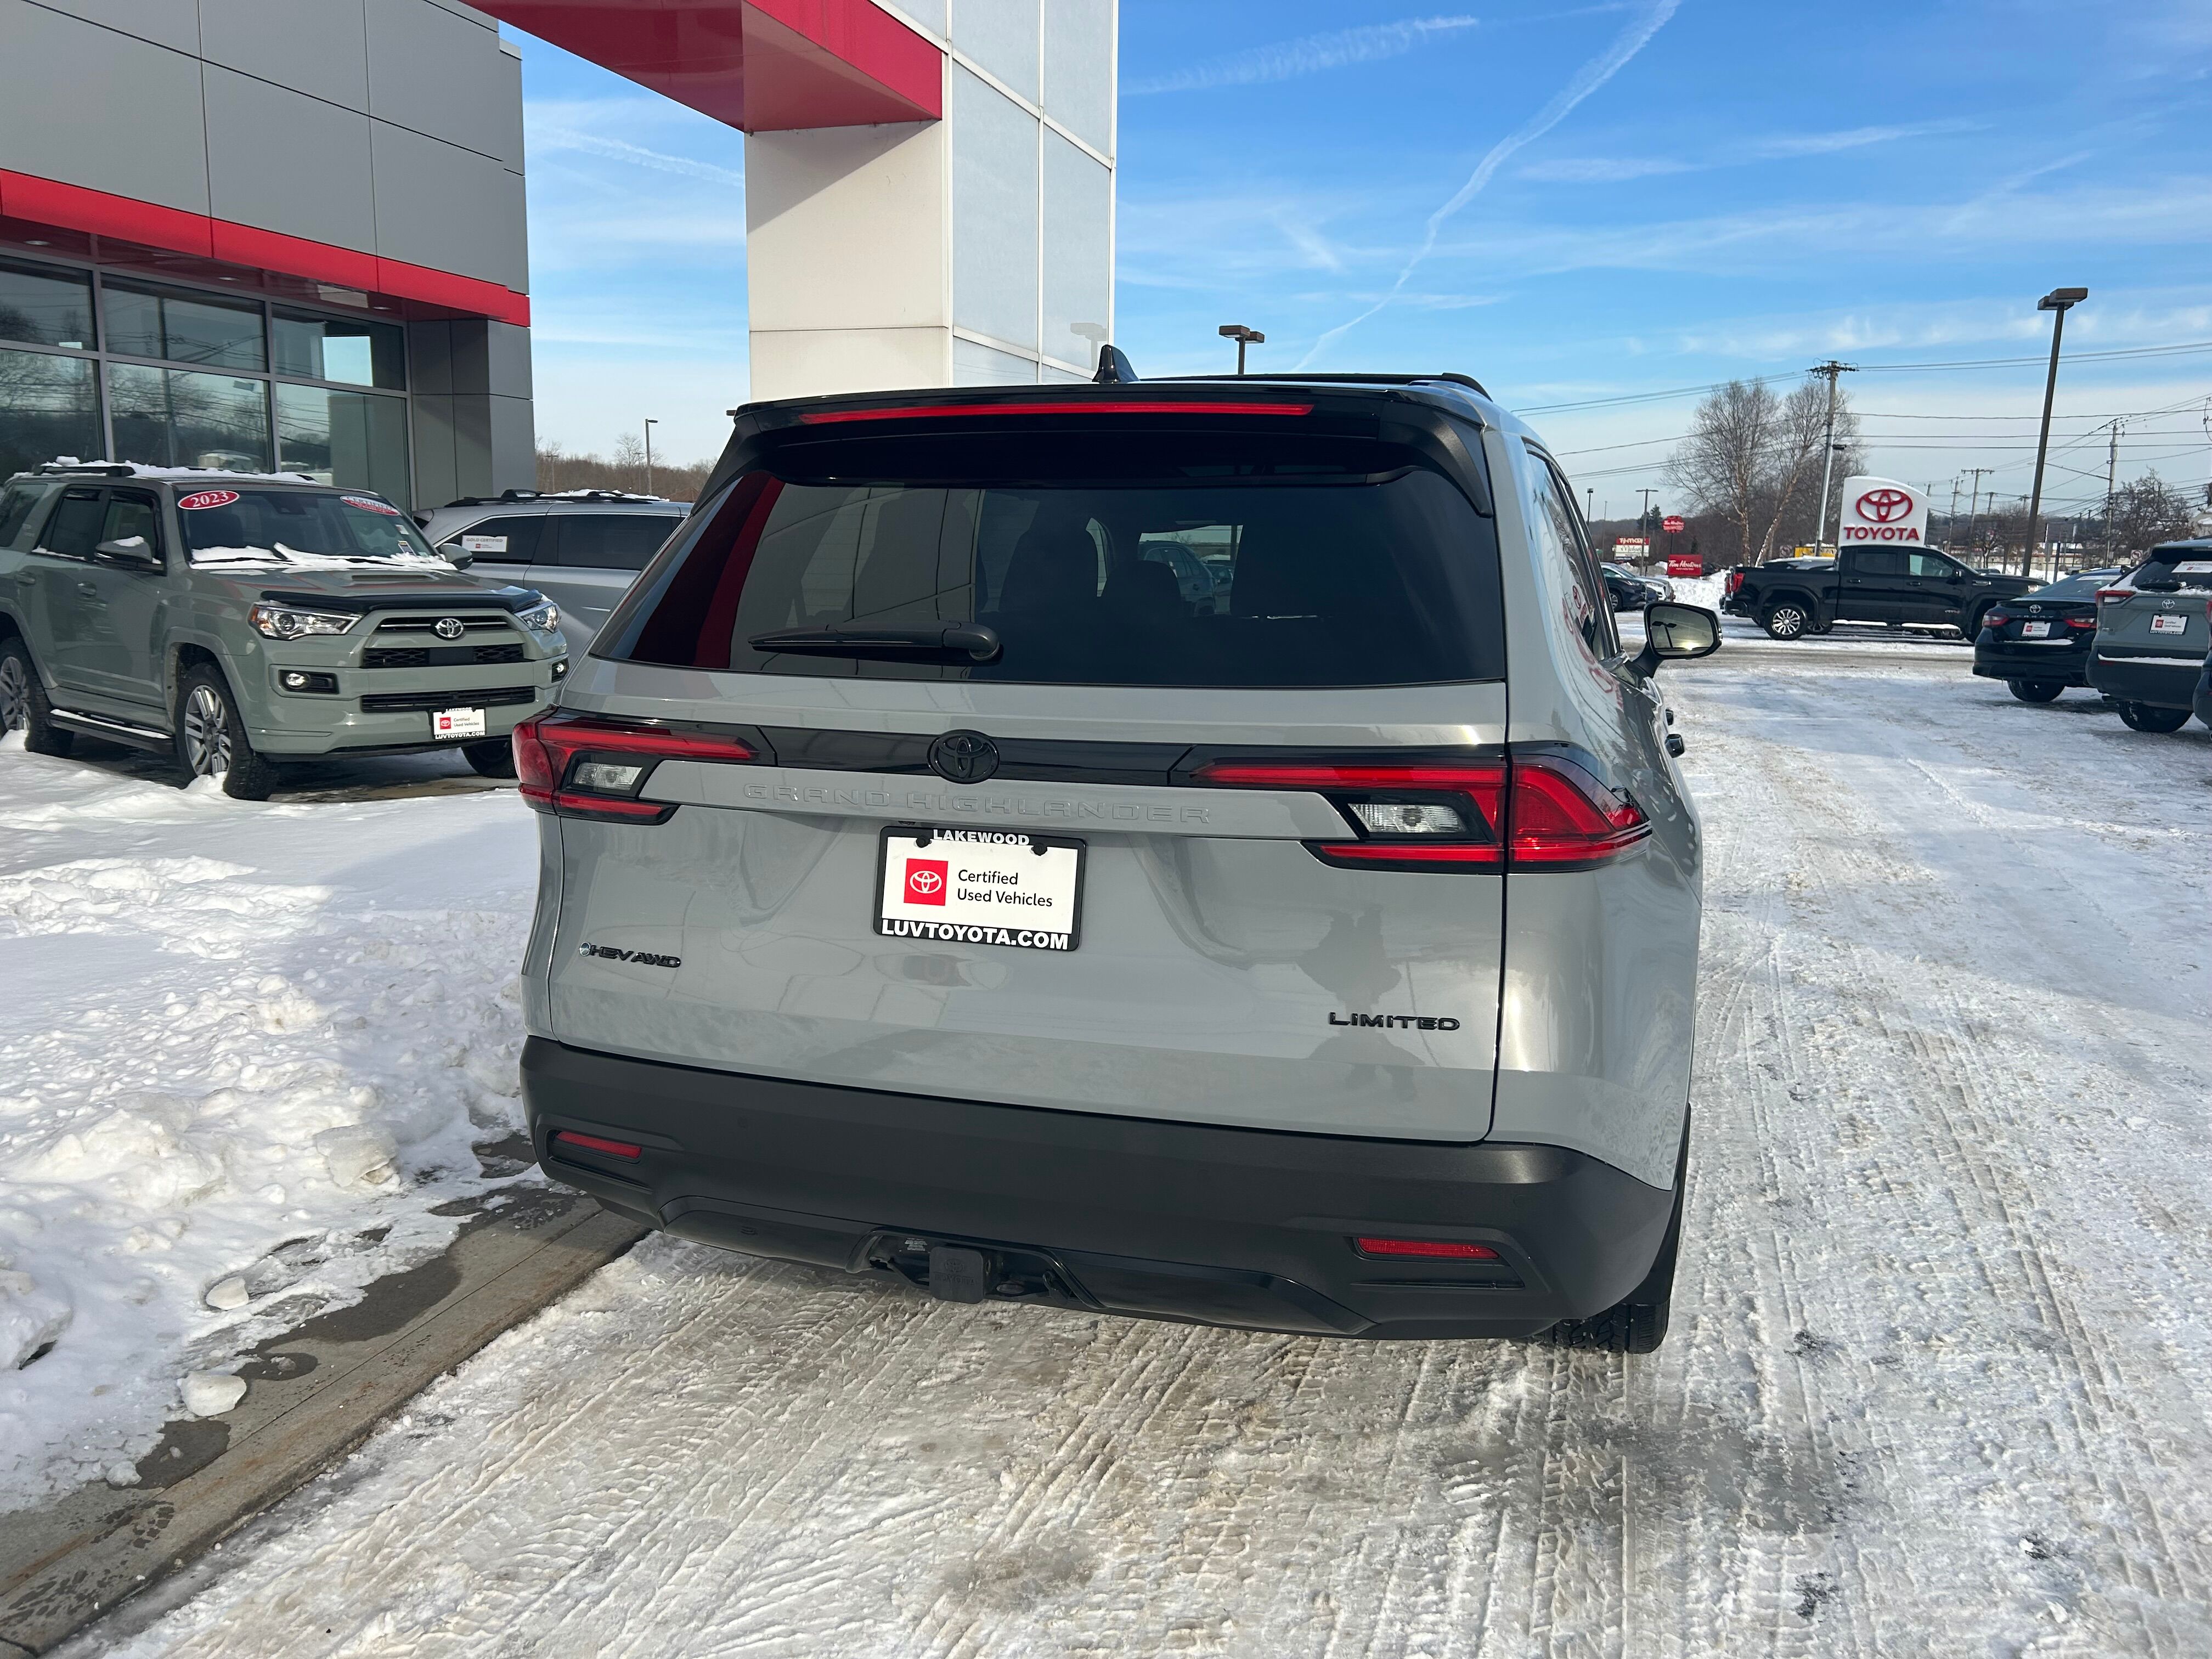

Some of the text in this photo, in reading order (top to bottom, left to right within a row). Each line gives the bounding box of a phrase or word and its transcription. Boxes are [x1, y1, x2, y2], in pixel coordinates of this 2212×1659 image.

[190, 492, 229, 507] 2023
[1843, 526, 1920, 541] TOYOTA
[1679, 560, 1701, 568] Hortons
[435, 731, 486, 740] LUVTOYOTA.COM
[743, 783, 1210, 823] GRAND HIGHLANDER
[932, 829, 1030, 846] LAKEWOOD
[958, 869, 1019, 885] Certified
[957, 888, 1053, 907] Used Vehicles
[881, 918, 1069, 950] LUVTOYOTA.COM
[590, 944, 681, 968] HEV AWD
[1329, 1012, 1460, 1031] LIMITED
